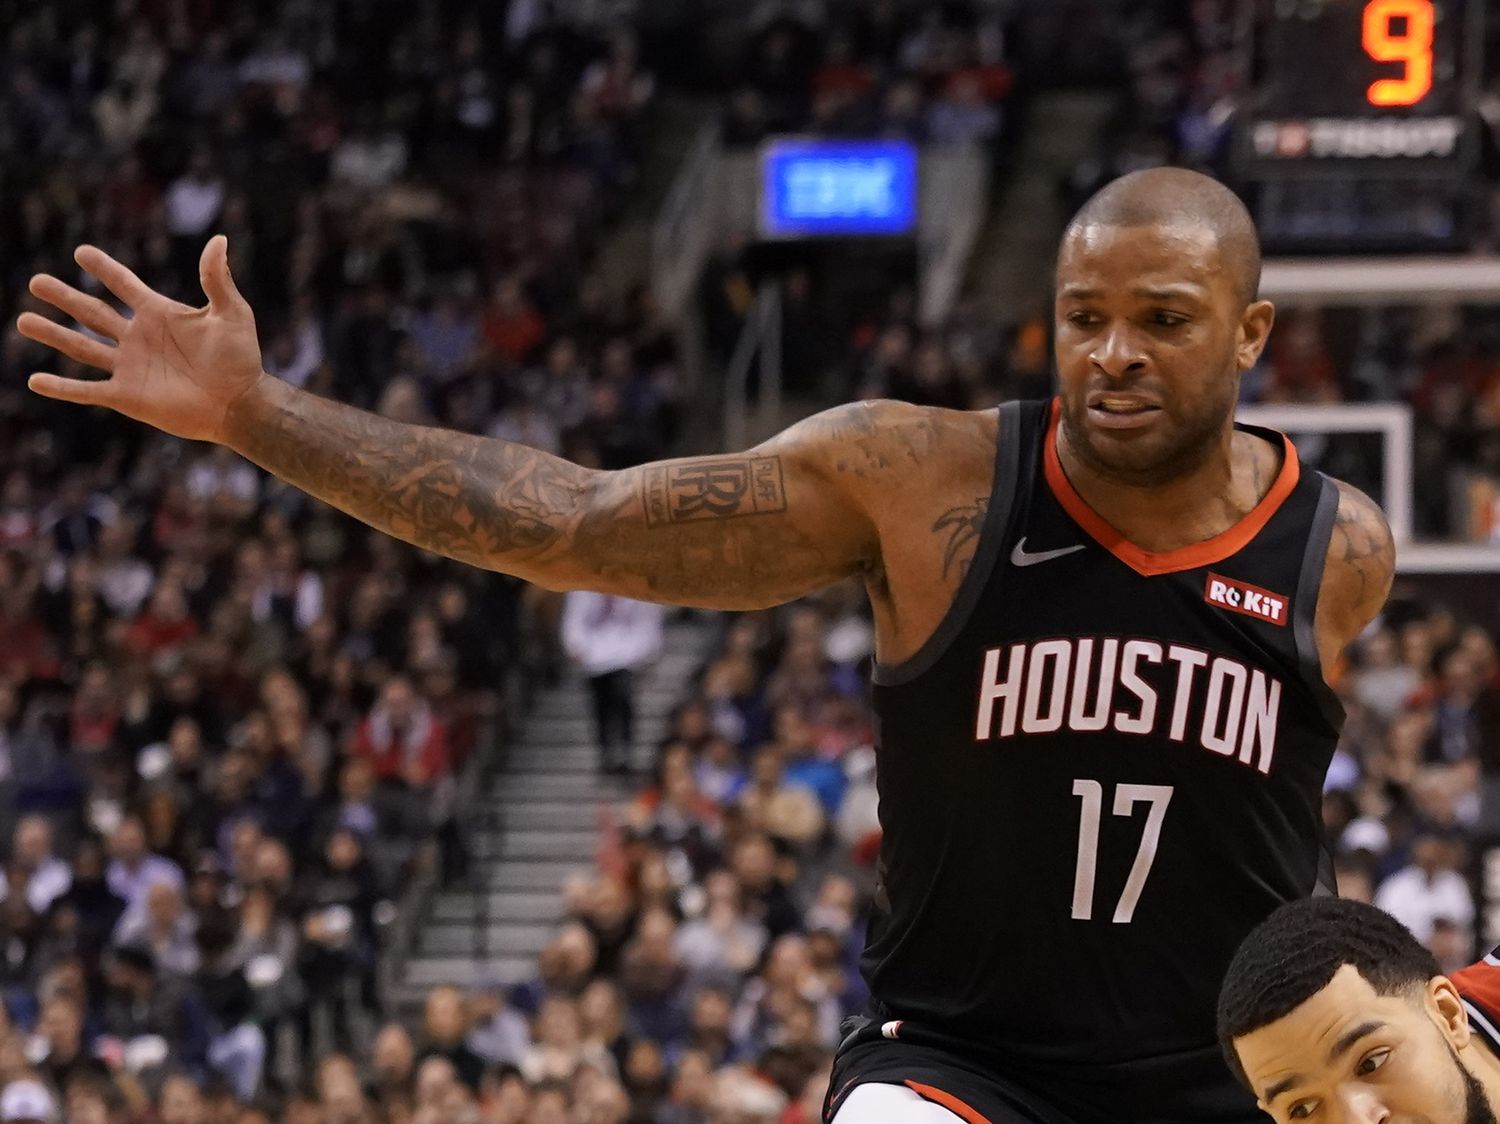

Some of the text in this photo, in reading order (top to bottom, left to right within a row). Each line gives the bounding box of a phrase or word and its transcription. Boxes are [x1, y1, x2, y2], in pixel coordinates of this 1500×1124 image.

[1362, 0, 1435, 106] 9
[974, 636, 1283, 776] HOUSTON
[1071, 778, 1174, 924] 17
